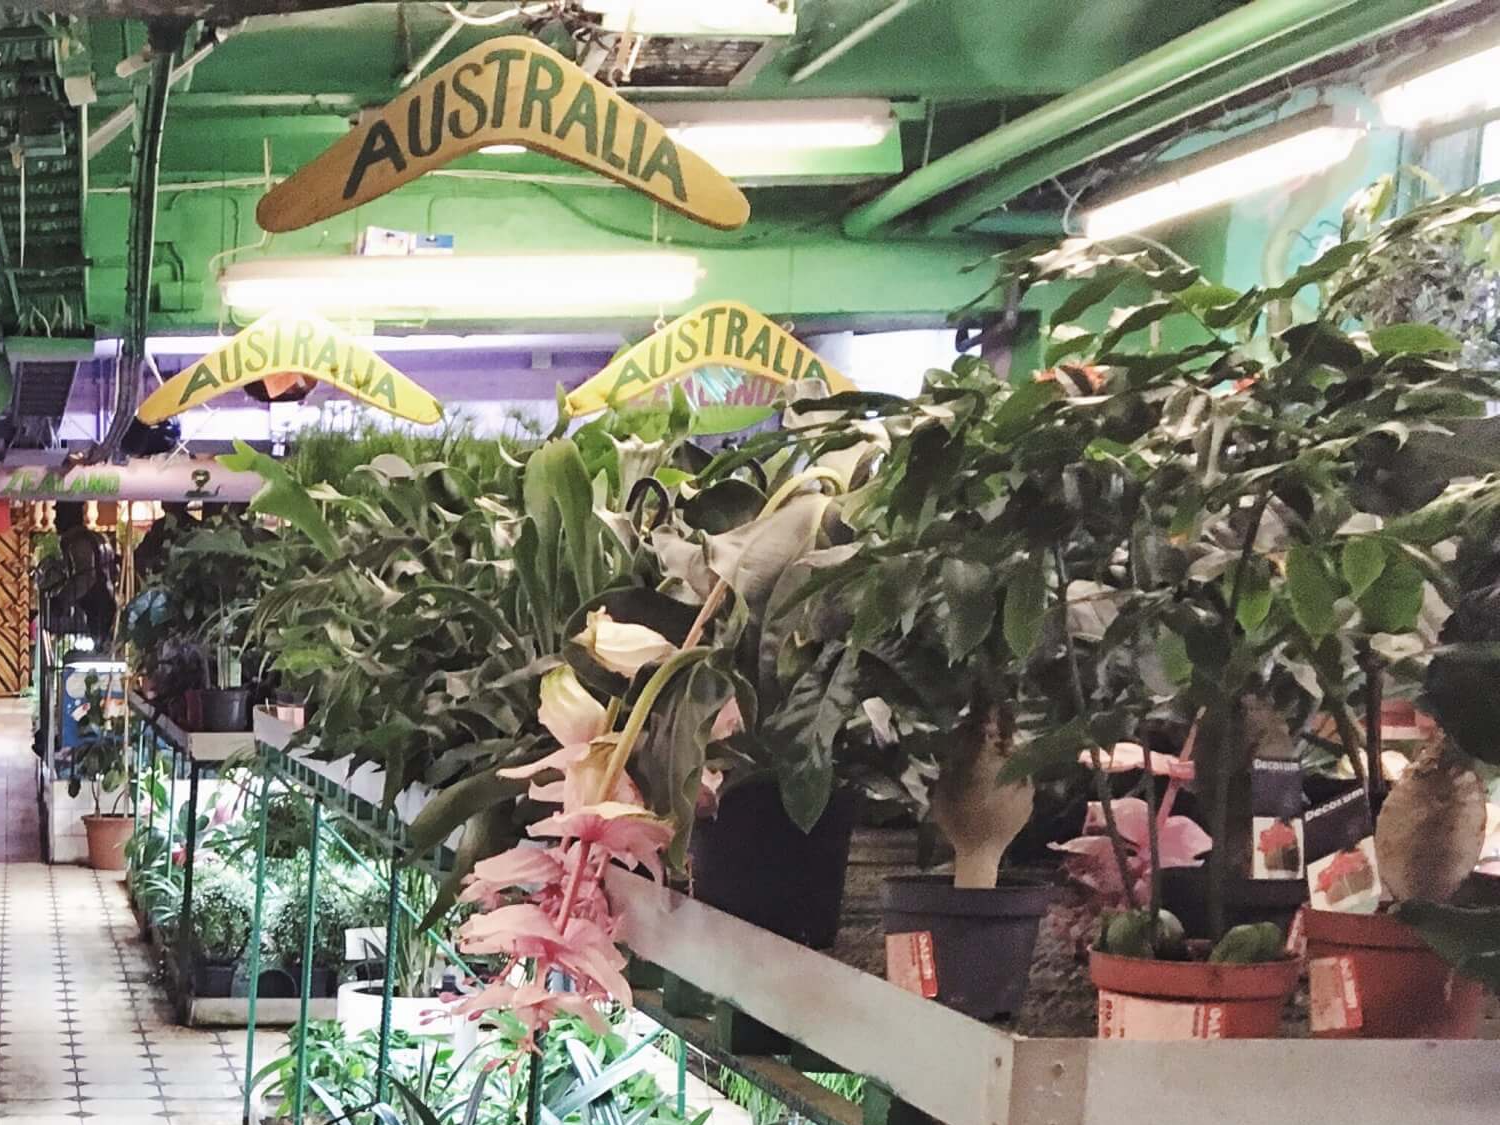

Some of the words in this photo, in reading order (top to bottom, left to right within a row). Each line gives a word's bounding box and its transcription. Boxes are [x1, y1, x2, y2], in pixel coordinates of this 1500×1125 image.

[342, 48, 689, 203] AUSTRALIA
[179, 318, 397, 408] AUSTRALIA
[606, 307, 831, 404] AUSTRALIA
[1304, 787, 1364, 822] Decorum
